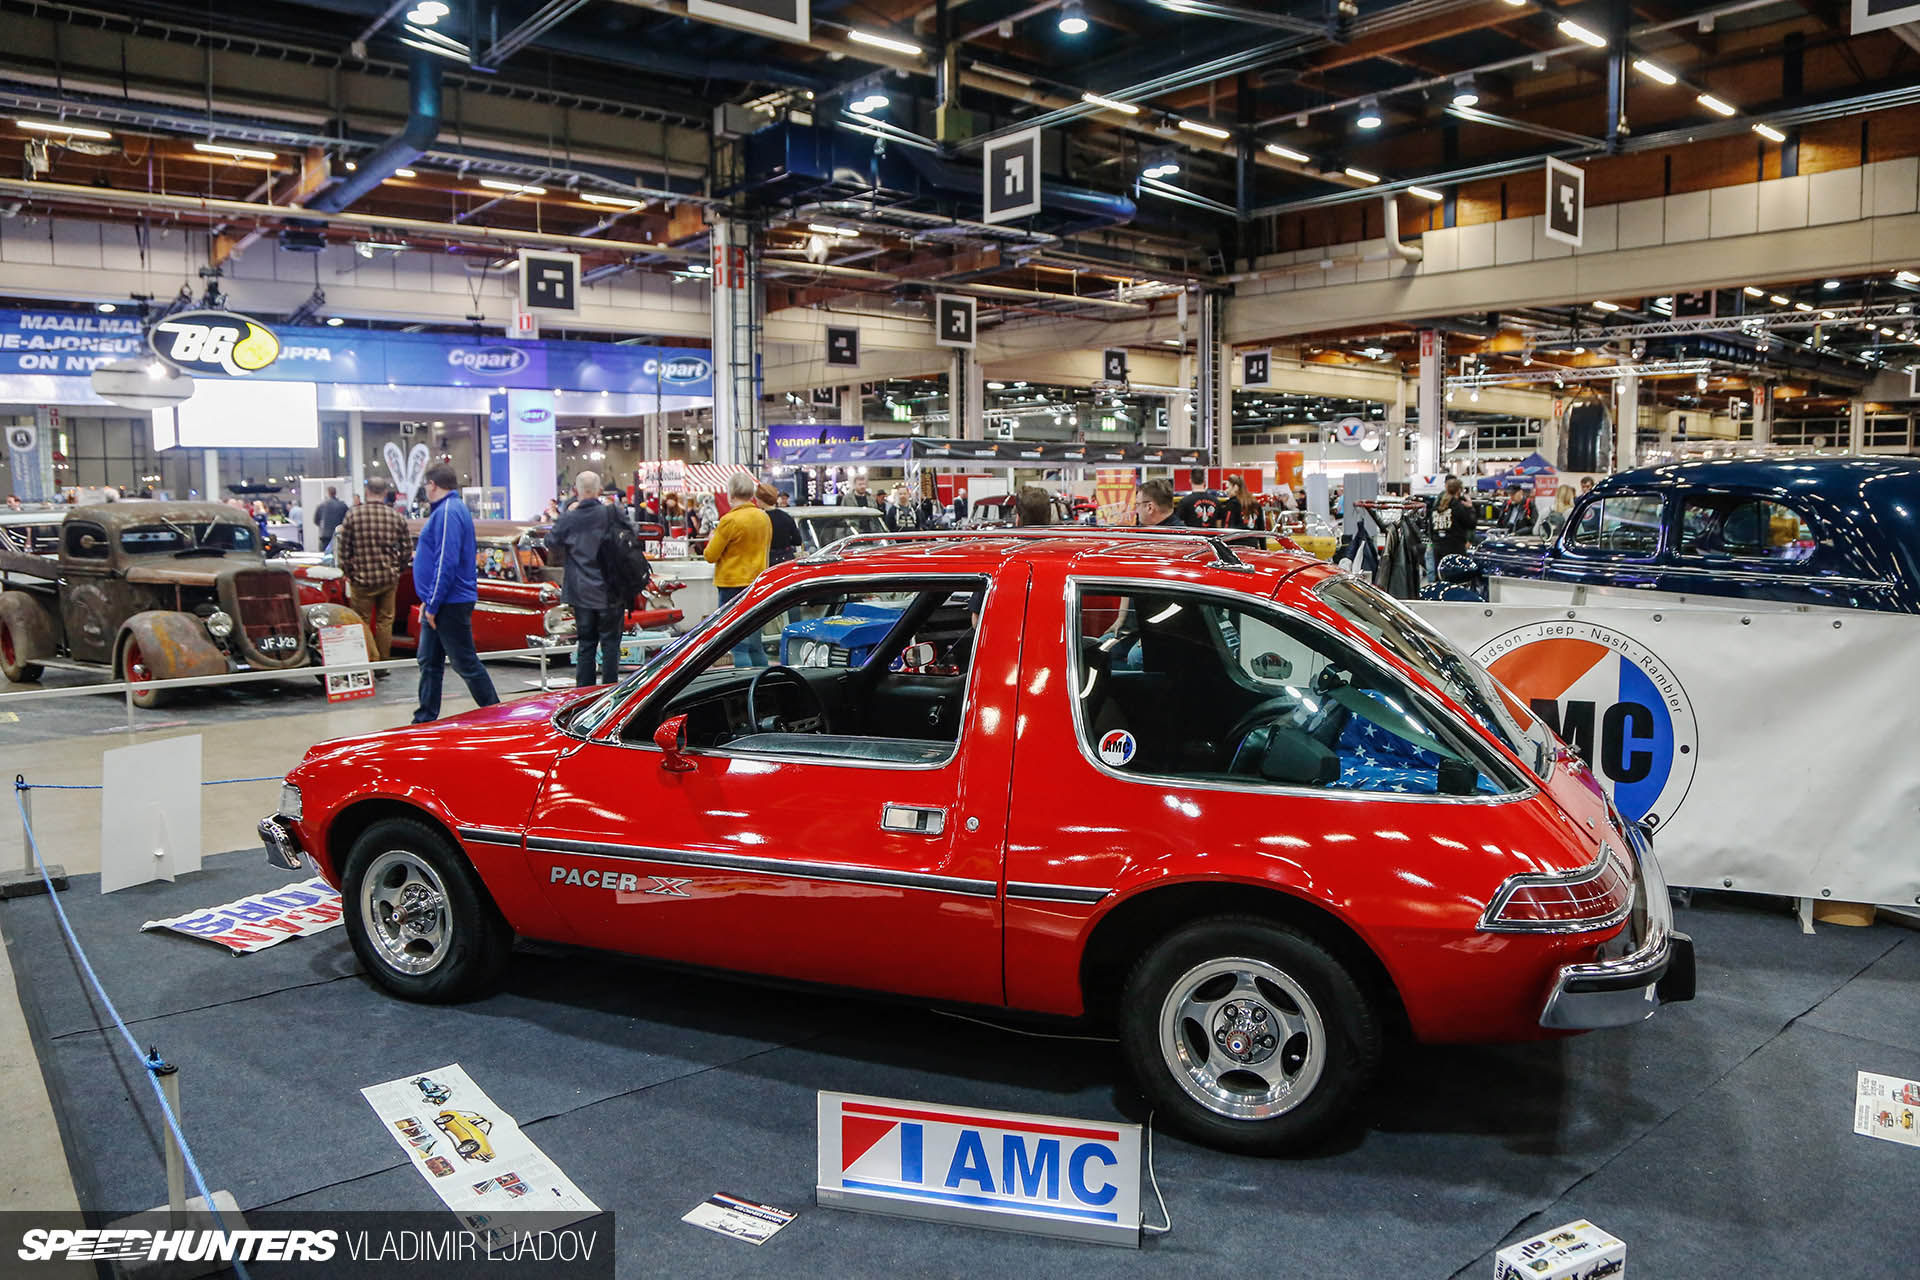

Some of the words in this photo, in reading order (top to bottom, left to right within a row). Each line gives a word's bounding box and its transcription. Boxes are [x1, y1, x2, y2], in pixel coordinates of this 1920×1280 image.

[0, 334, 142, 353] E-AJONEU
[19, 354, 59, 370] ON
[448, 349, 520, 369] Copart
[1480, 634, 1523, 664] udson
[1537, 624, 1574, 637] Jeep
[1591, 627, 1630, 652] Nash
[1640, 655, 1682, 714] Rambler
[1104, 740, 1131, 754] AMC
[1529, 698, 1655, 784] MC
[550, 866, 638, 892] PACER
[645, 875, 693, 897] X
[944, 1129, 1118, 1206] AMC
